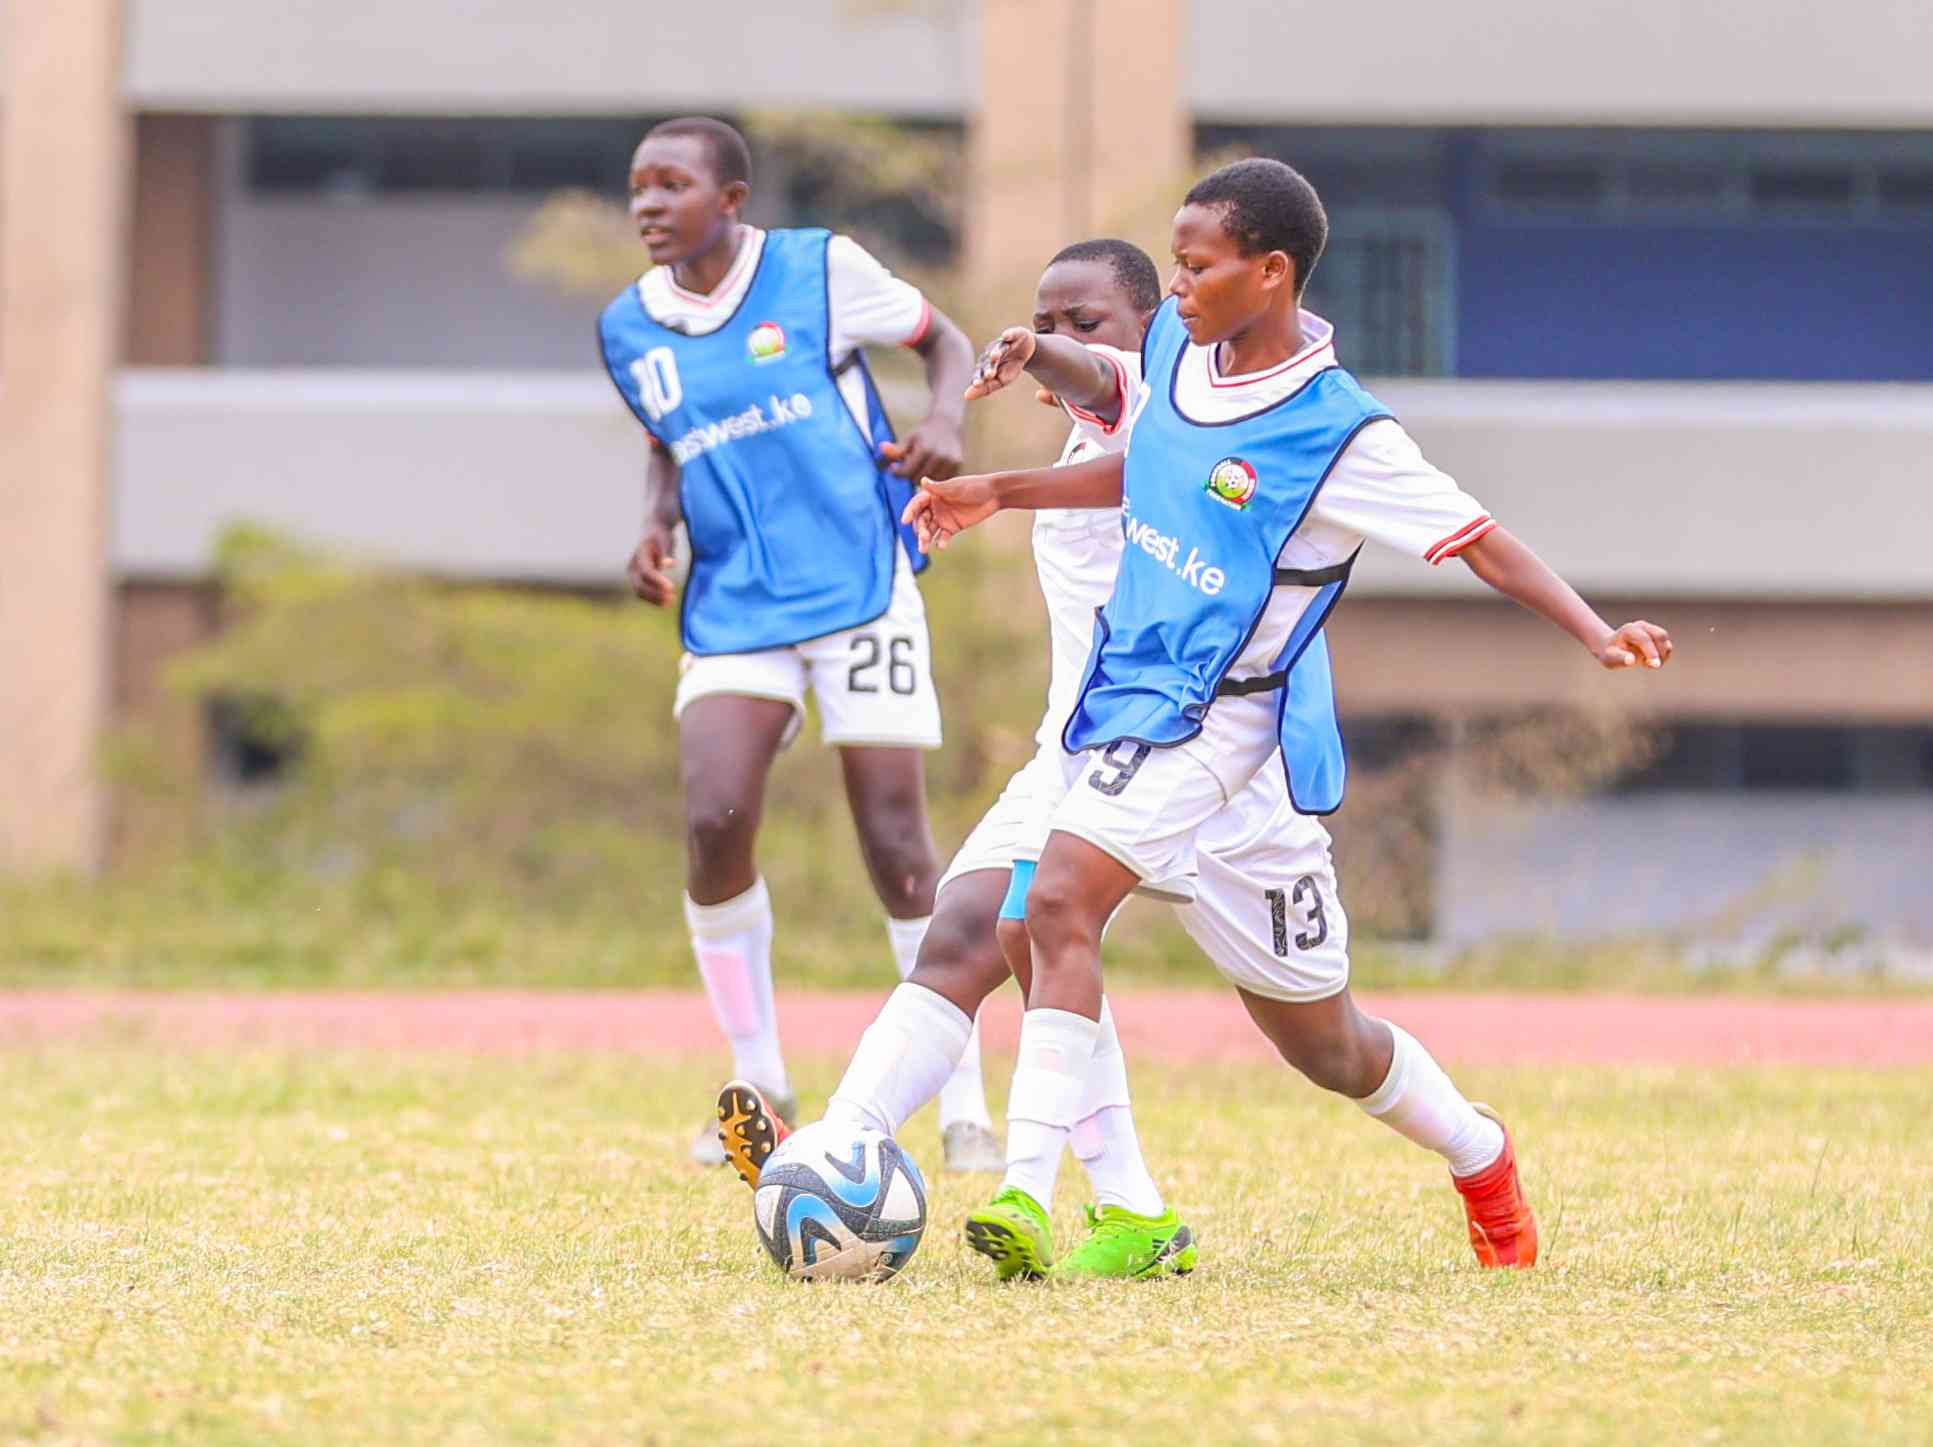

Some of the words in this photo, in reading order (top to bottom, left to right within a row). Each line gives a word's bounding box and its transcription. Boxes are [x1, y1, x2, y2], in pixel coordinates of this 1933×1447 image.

[629, 346, 683, 422] 10
[848, 636, 916, 695] 26
[1088, 739, 1152, 797] 9
[1264, 875, 1328, 957] 13
